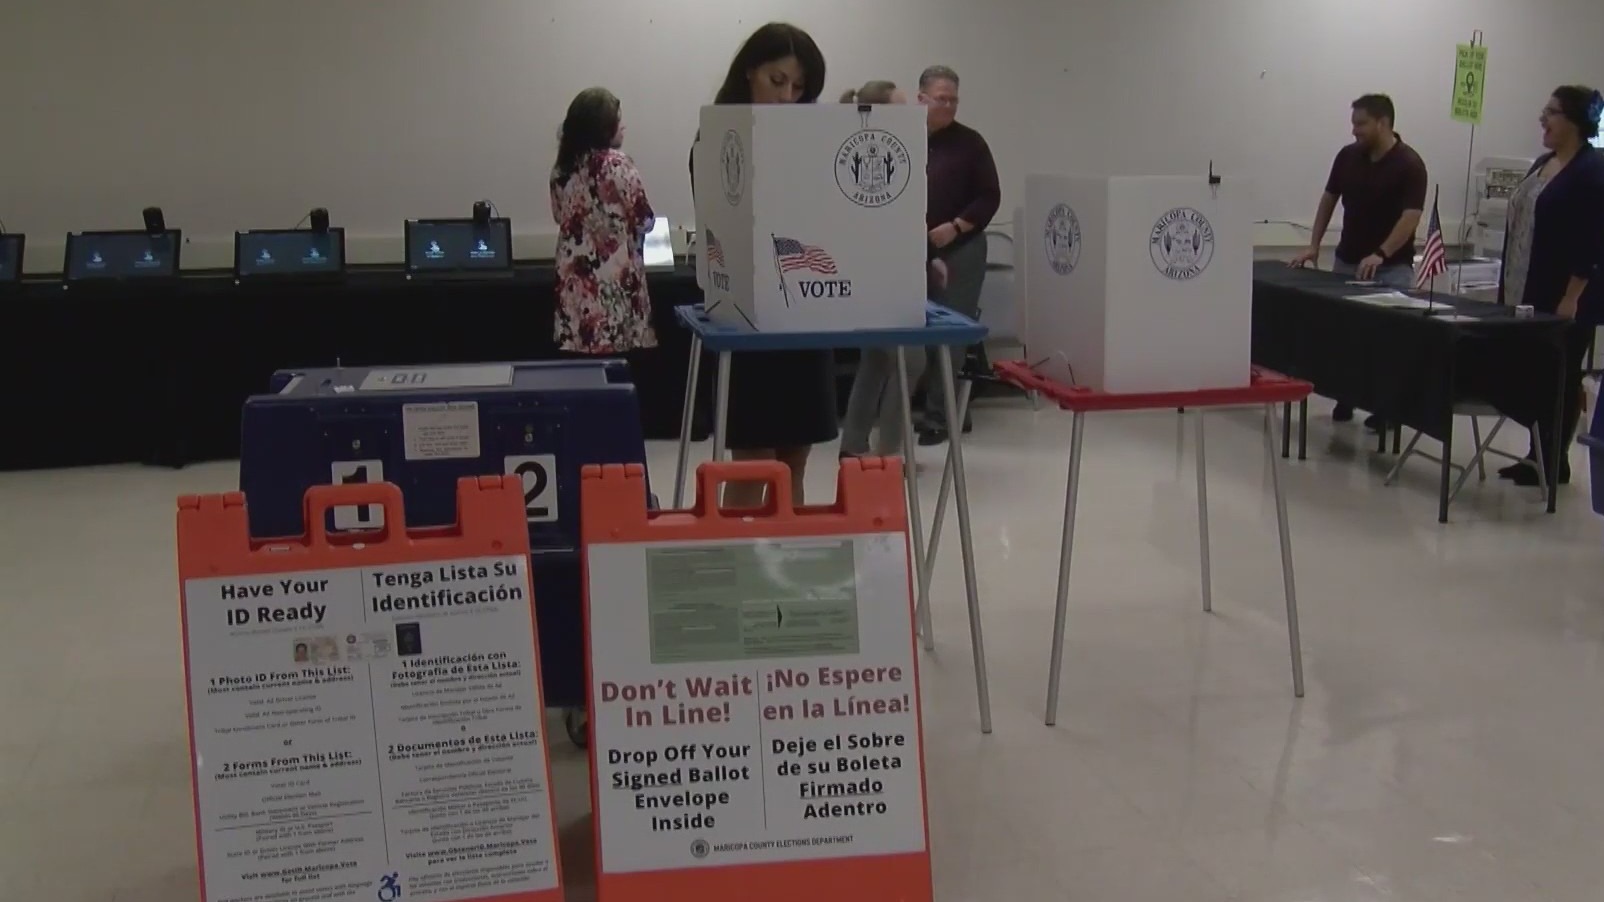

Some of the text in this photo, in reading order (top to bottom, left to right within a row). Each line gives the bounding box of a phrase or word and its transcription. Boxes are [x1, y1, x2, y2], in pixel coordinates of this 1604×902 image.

[839, 134, 906, 165] MARICOPA COUNTY
[854, 192, 891, 203] ARIZONA
[1166, 265, 1200, 278] ARIZONA
[798, 280, 851, 298] VOTE
[342, 466, 369, 521] 1
[515, 462, 548, 516] 2
[373, 561, 516, 588] Tenga Lista Su
[221, 580, 328, 599] Have Your
[372, 584, 522, 612] Identificación
[228, 602, 326, 625] ID Ready
[411, 654, 484, 667] Identificación
[488, 651, 506, 659] con
[451, 666, 463, 674] de
[467, 664, 489, 672] Esta
[220, 676, 252, 685] Photo
[256, 674, 266, 682] ID
[270, 672, 298, 680] From
[302, 668, 324, 677] This
[328, 666, 350, 675] List:
[767, 666, 901, 691] ¡No Espere
[686, 674, 752, 698] Wait
[626, 702, 730, 727] In Line!
[764, 694, 909, 720] en la Línea!
[388, 746, 394, 754] 2
[397, 738, 465, 752] Documentos
[468, 736, 481, 744] de
[772, 732, 904, 757] Deje el Sobre
[233, 760, 268, 770] Forms
[271, 757, 299, 766] From
[303, 754, 325, 763] This
[329, 751, 352, 760] List:
[609, 744, 750, 766] Drop Off Your
[778, 756, 901, 776] de su Boleta
[612, 766, 750, 790] Signed Ballot
[800, 778, 883, 798] Firmado
[636, 792, 729, 809] Envelope
[804, 802, 886, 819] Adentro
[653, 814, 715, 831] Inside
[714, 844, 748, 852] MARICOPA
[750, 841, 775, 850] COUNTY
[776, 839, 810, 848] ELECTIONS
[812, 835, 853, 846] DEPARTMENT
